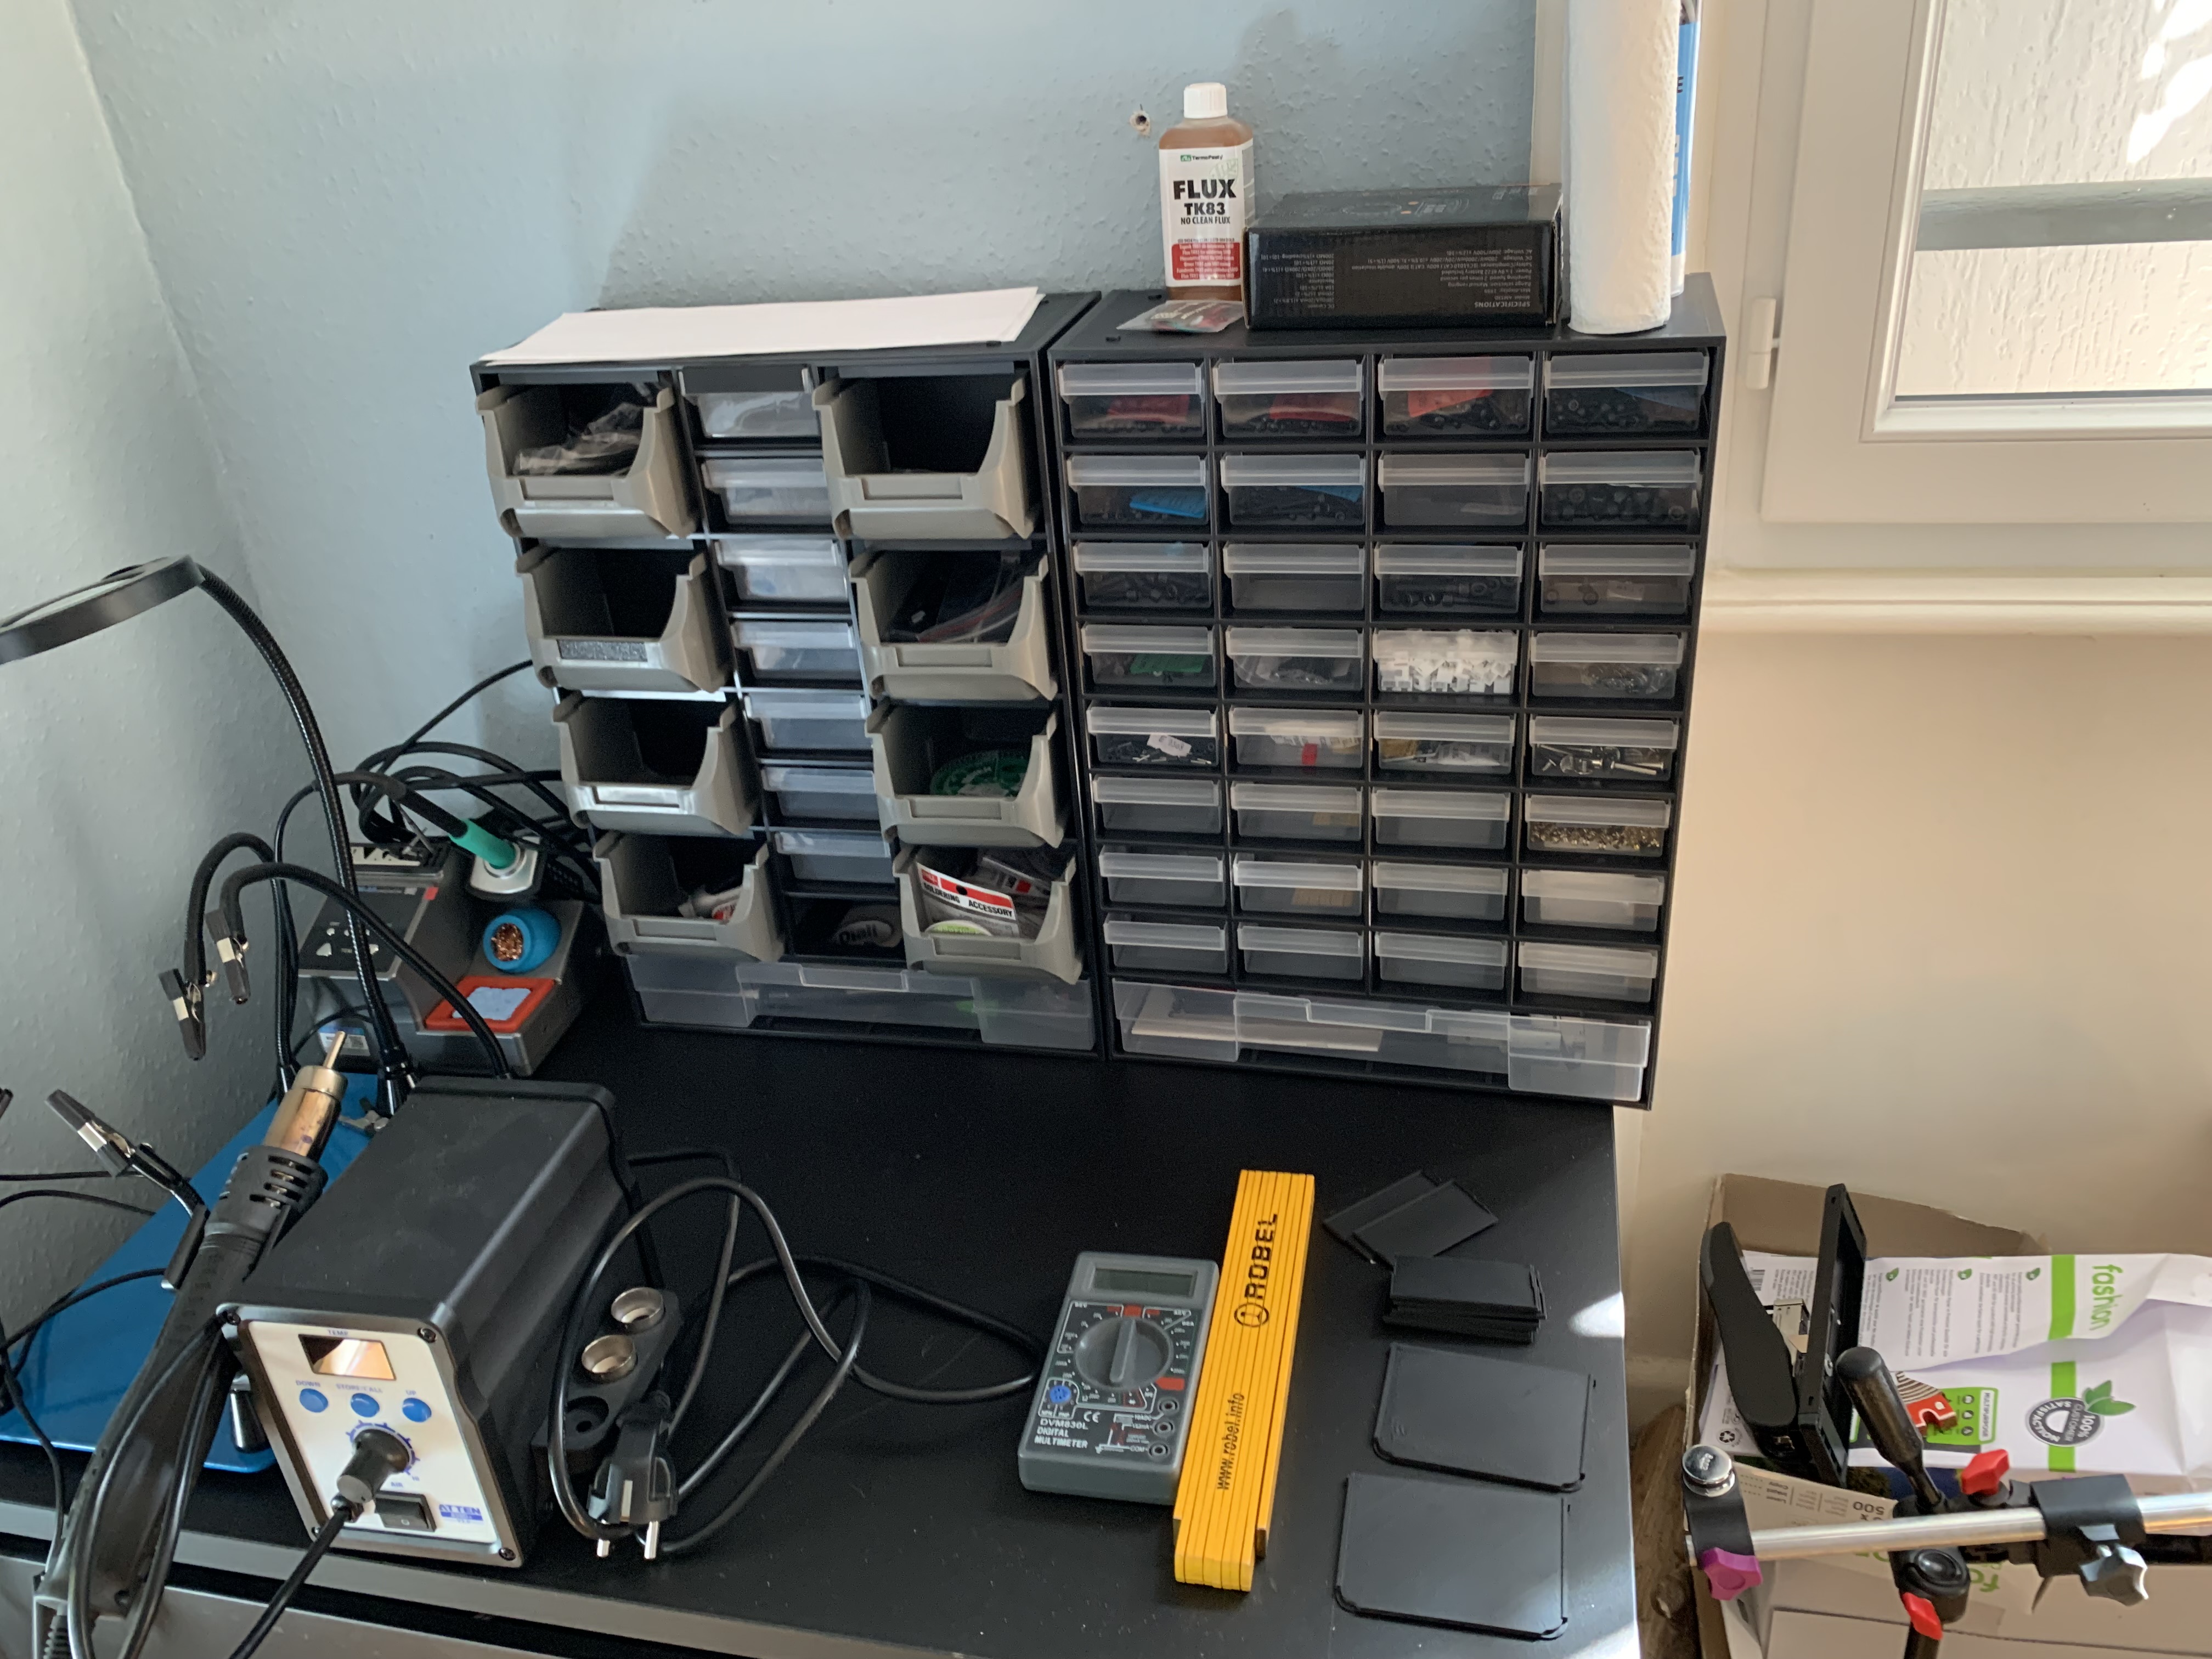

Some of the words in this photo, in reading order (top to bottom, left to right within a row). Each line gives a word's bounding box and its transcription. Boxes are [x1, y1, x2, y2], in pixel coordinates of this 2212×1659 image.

[1173, 178, 1237, 200] FLUX
[1184, 202, 1226, 216] TK83
[923, 882, 960, 904] SOLDERING
[968, 900, 1013, 917] ACCESSORY
[1244, 1214, 1277, 1299] ROBEL
[2089, 1264, 2124, 1331] fashion
[295, 1379, 321, 1387] DOWN
[1981, 1392, 1991, 1437] MULTIPURPOSE
[1037, 1426, 1069, 1437] DIGITAL
[1040, 1418, 1088, 1430] DVM830L
[2077, 1415, 2096, 1438] 100%
[1034, 1435, 1088, 1448] MULTIMETER
[1217, 1393, 1245, 1490] www.robel.info
[439, 1504, 481, 1515] ATTEN
[1853, 1501, 1885, 1515] 500
